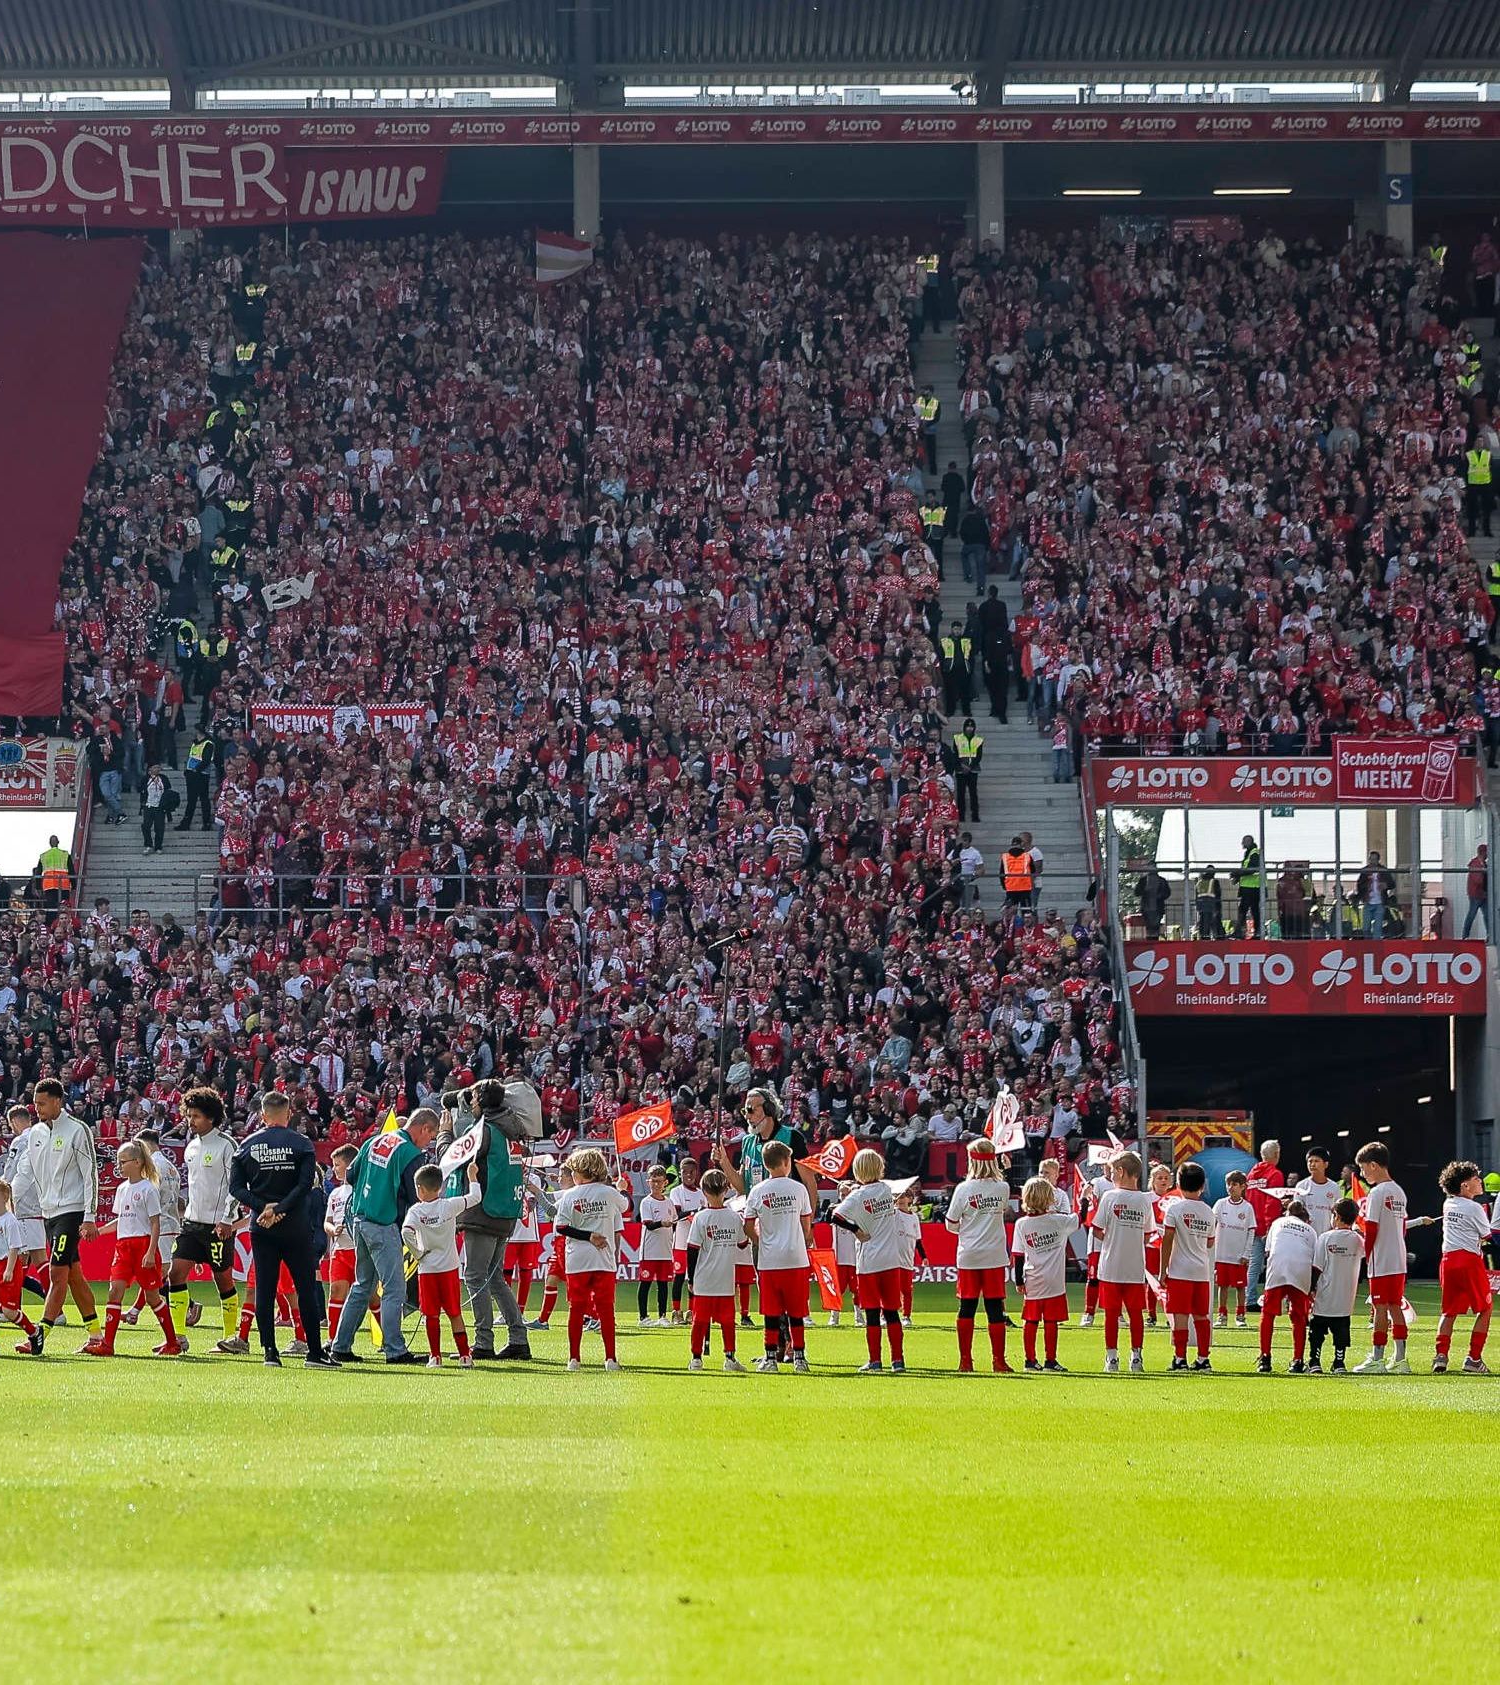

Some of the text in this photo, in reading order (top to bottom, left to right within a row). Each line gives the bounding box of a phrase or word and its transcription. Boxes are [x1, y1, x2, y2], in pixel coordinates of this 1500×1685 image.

[468, 122, 505, 134] LOTTO
[542, 122, 580, 132] LOTTO
[618, 120, 655, 132] LOTTO
[693, 120, 730, 132] LOTTO
[768, 120, 806, 132] LOTTO
[844, 120, 881, 132] LOTTO
[918, 119, 956, 131] LOTTO
[994, 119, 1032, 130] LOTTO
[1070, 119, 1106, 130] LOTTO
[1139, 118, 1176, 130] LOTTO
[1214, 118, 1251, 130] LOTTO
[1290, 118, 1327, 129] LOTTO
[1366, 117, 1402, 128] LOTTO
[1444, 116, 1480, 128] LOTTO
[92, 125, 131, 136] LOTTO
[167, 124, 205, 136] LOTTO
[242, 124, 280, 135] LOTTO
[317, 124, 355, 135] LOTTO
[392, 123, 430, 134] LOTTO
[1390, 180, 1401, 198] S
[261, 570, 317, 612] FSV
[1137, 767, 1209, 788] LOTTO
[1261, 766, 1333, 787] LOTTO
[1355, 770, 1413, 789] MEENZ
[1137, 791, 1192, 800] Rheinland-Pfalz
[1261, 790, 1316, 800] Rheinland-Pfalz
[1176, 953, 1294, 985] LOTTO
[1364, 952, 1482, 984] LOTTO
[1176, 992, 1267, 1005] Rheinland-Pfalz
[1364, 992, 1454, 1005] Rheinland-Pfalz
[260, 1148, 294, 1156] FUSSBALL
[260, 1154, 286, 1163] SCHULE
[770, 1196, 796, 1204] FUSSBALL
[1033, 1232, 1059, 1242] FUSSBALL
[1034, 1238, 1055, 1248] SCHULE
[211, 1242, 224, 1260] 27
